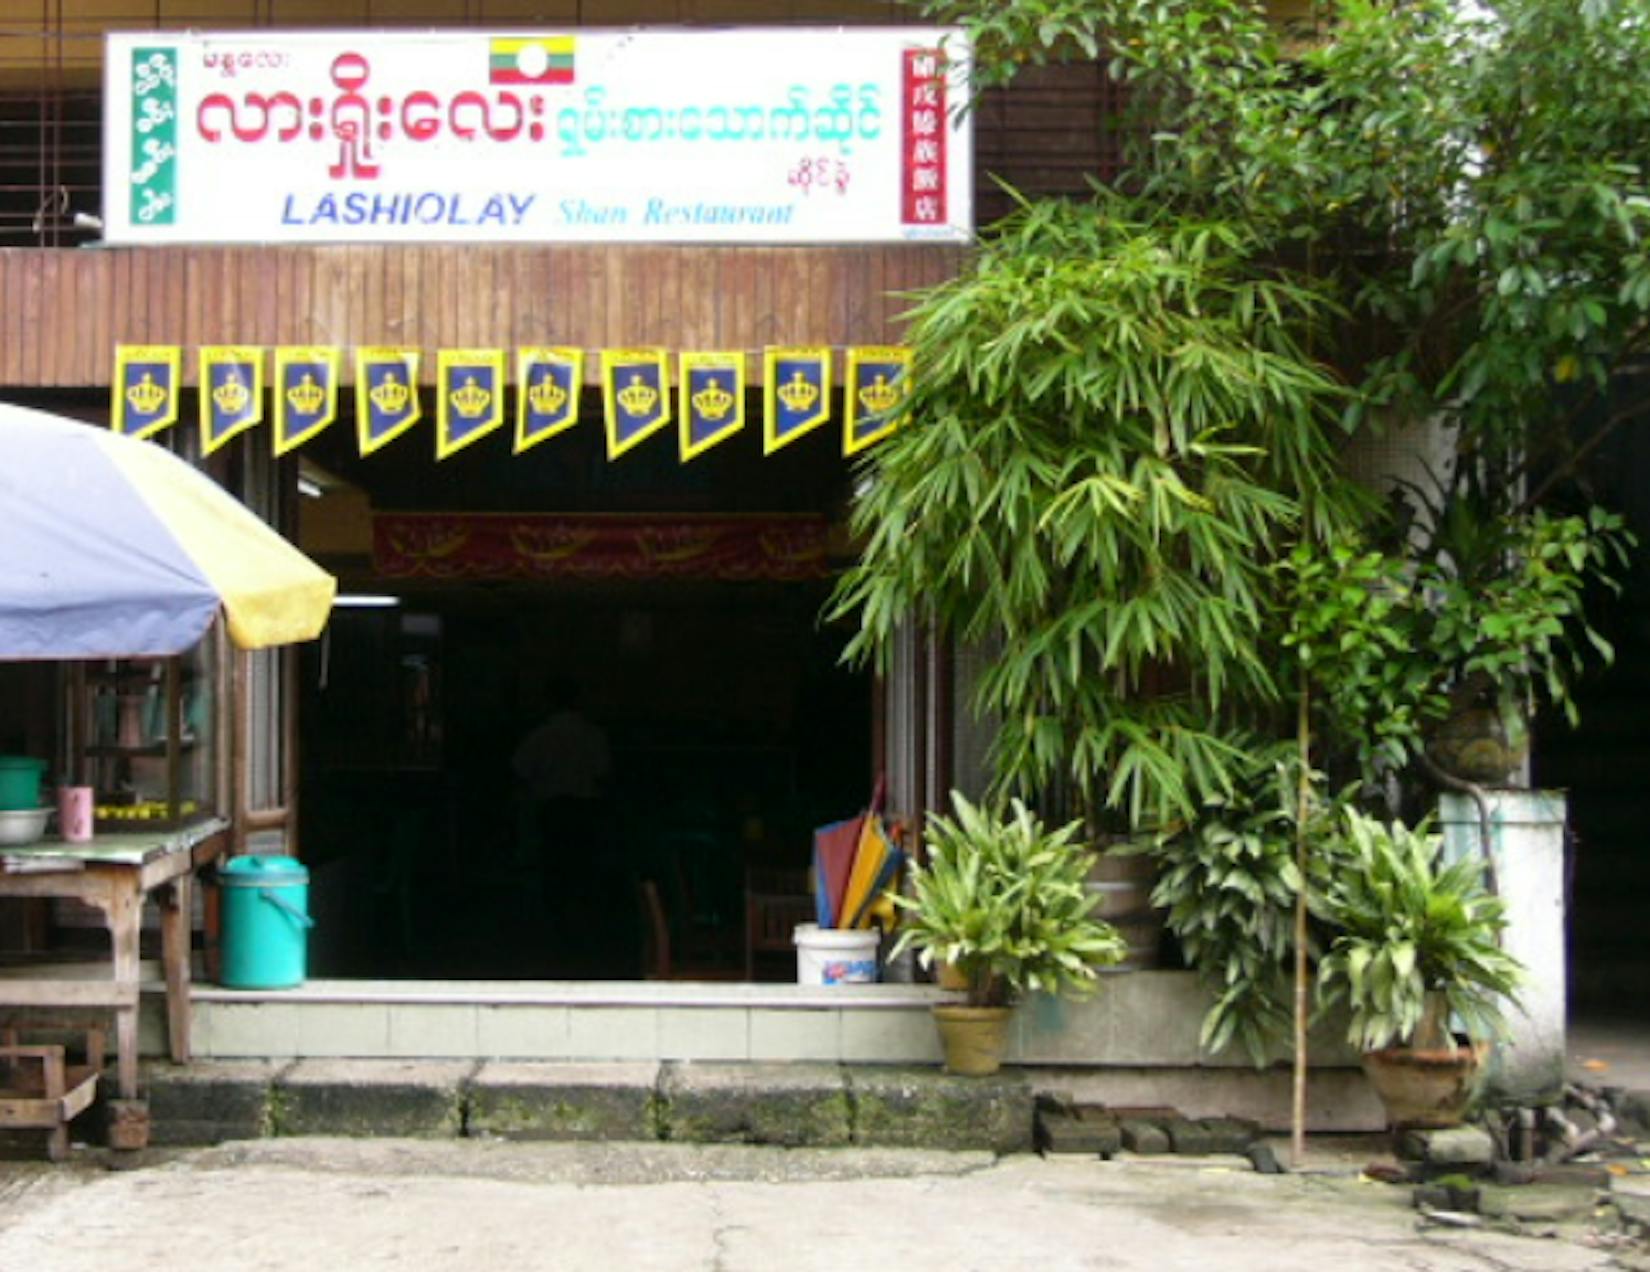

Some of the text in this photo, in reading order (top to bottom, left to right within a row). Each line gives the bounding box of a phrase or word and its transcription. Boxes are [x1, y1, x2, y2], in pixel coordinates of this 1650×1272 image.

[281, 192, 794, 226] LASHIOLAY Shan Restaurant
